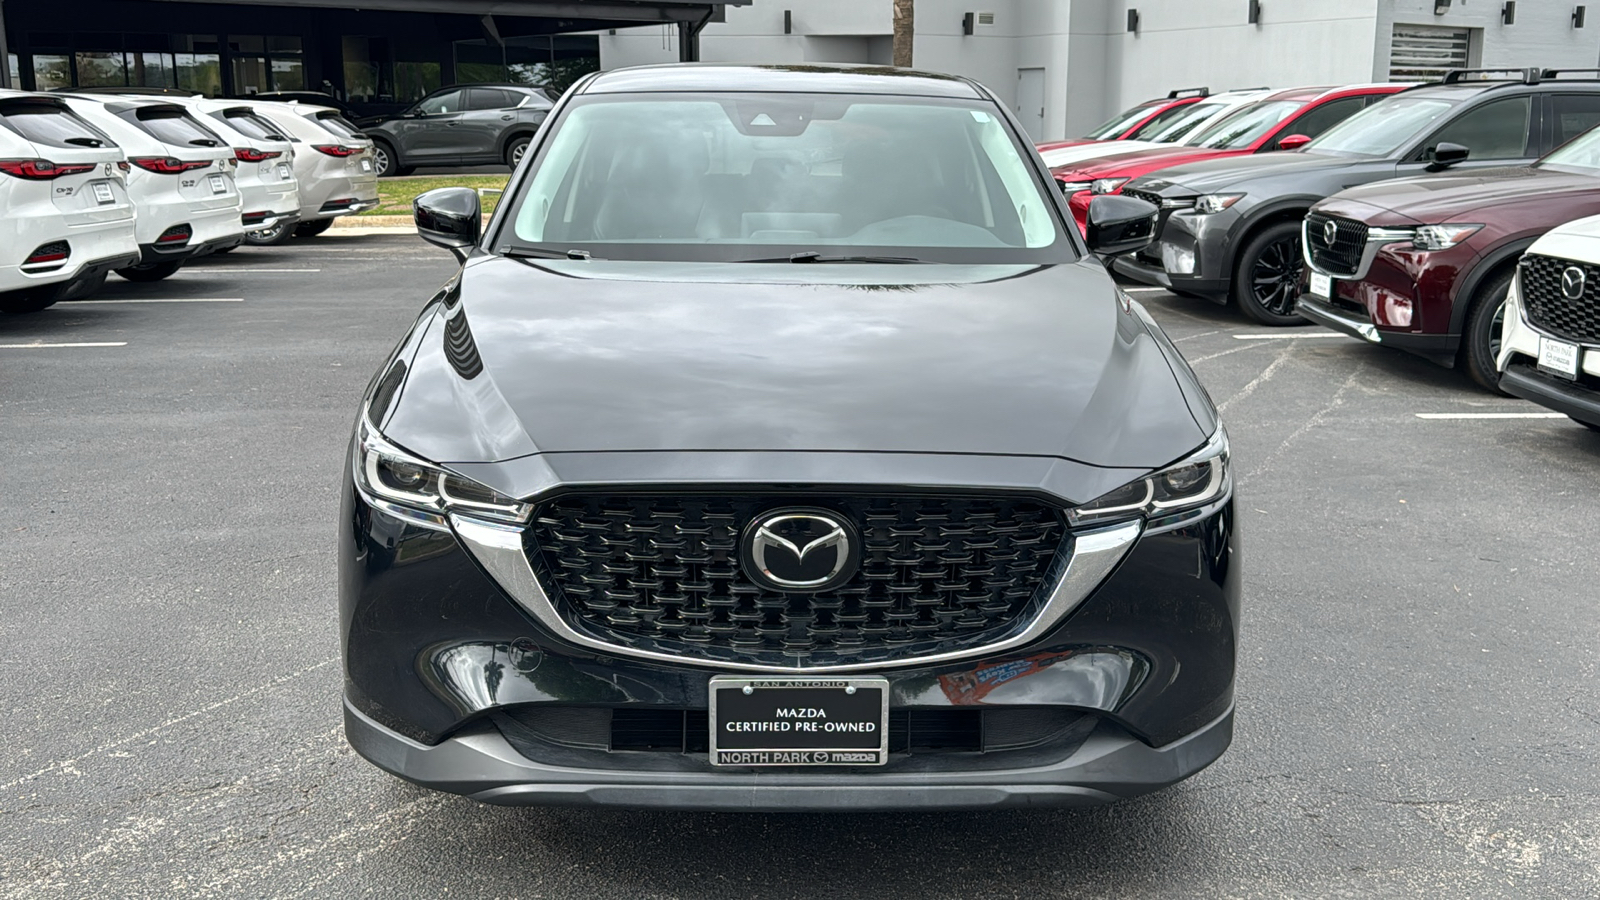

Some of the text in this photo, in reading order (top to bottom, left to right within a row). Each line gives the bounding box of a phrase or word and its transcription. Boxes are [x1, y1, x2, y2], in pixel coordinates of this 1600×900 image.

[776, 708, 826, 718] MAZDA
[726, 721, 876, 732] CERTIFIED PRE-OWNED
[721, 752, 876, 763] NORTH PARK mazda
